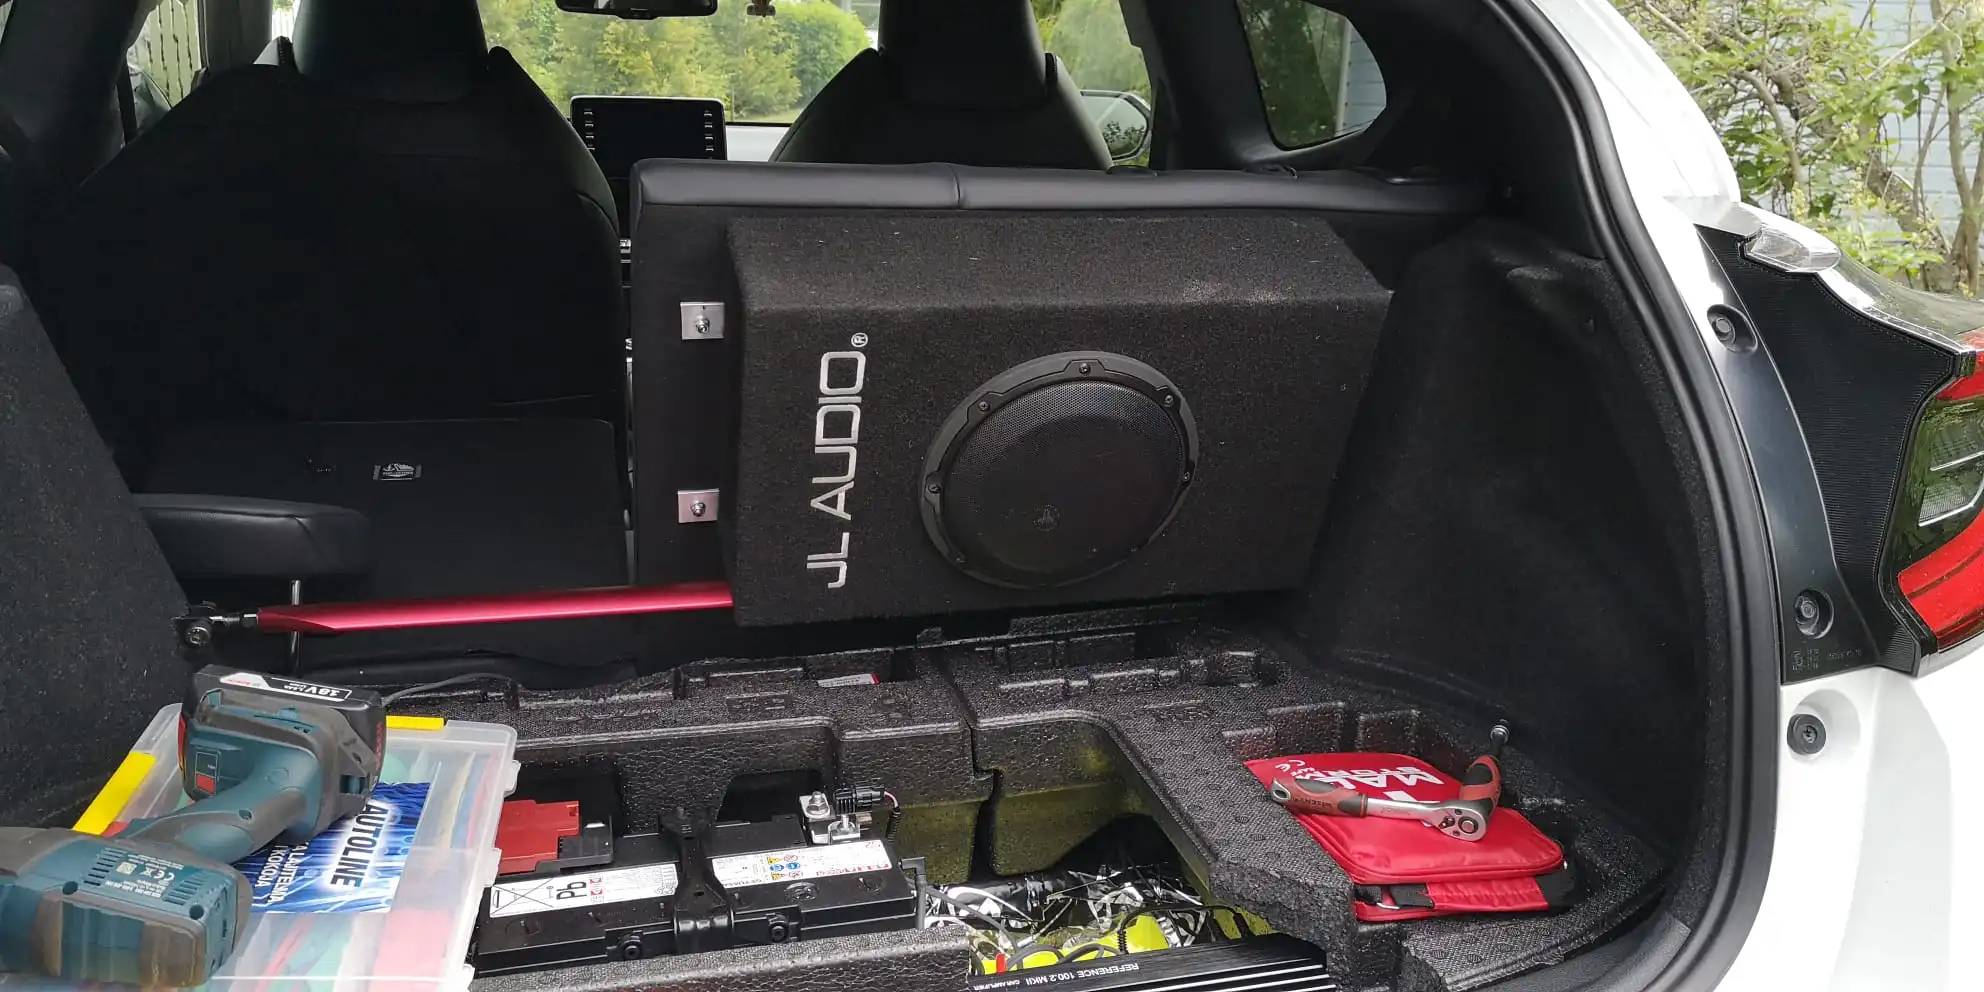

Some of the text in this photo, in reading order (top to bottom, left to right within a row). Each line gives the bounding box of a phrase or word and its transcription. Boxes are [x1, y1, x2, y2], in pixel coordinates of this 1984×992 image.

[807, 532, 849, 588] JL
[305, 686, 340, 697] 18V
[330, 803, 390, 888] AUTOLINE
[254, 849, 289, 888] KOKOJA
[556, 881, 587, 900] Pb
[1050, 974, 1075, 983] 100.2
[1078, 962, 1139, 979] REFERENCE
[1025, 976, 1048, 986] MKII
